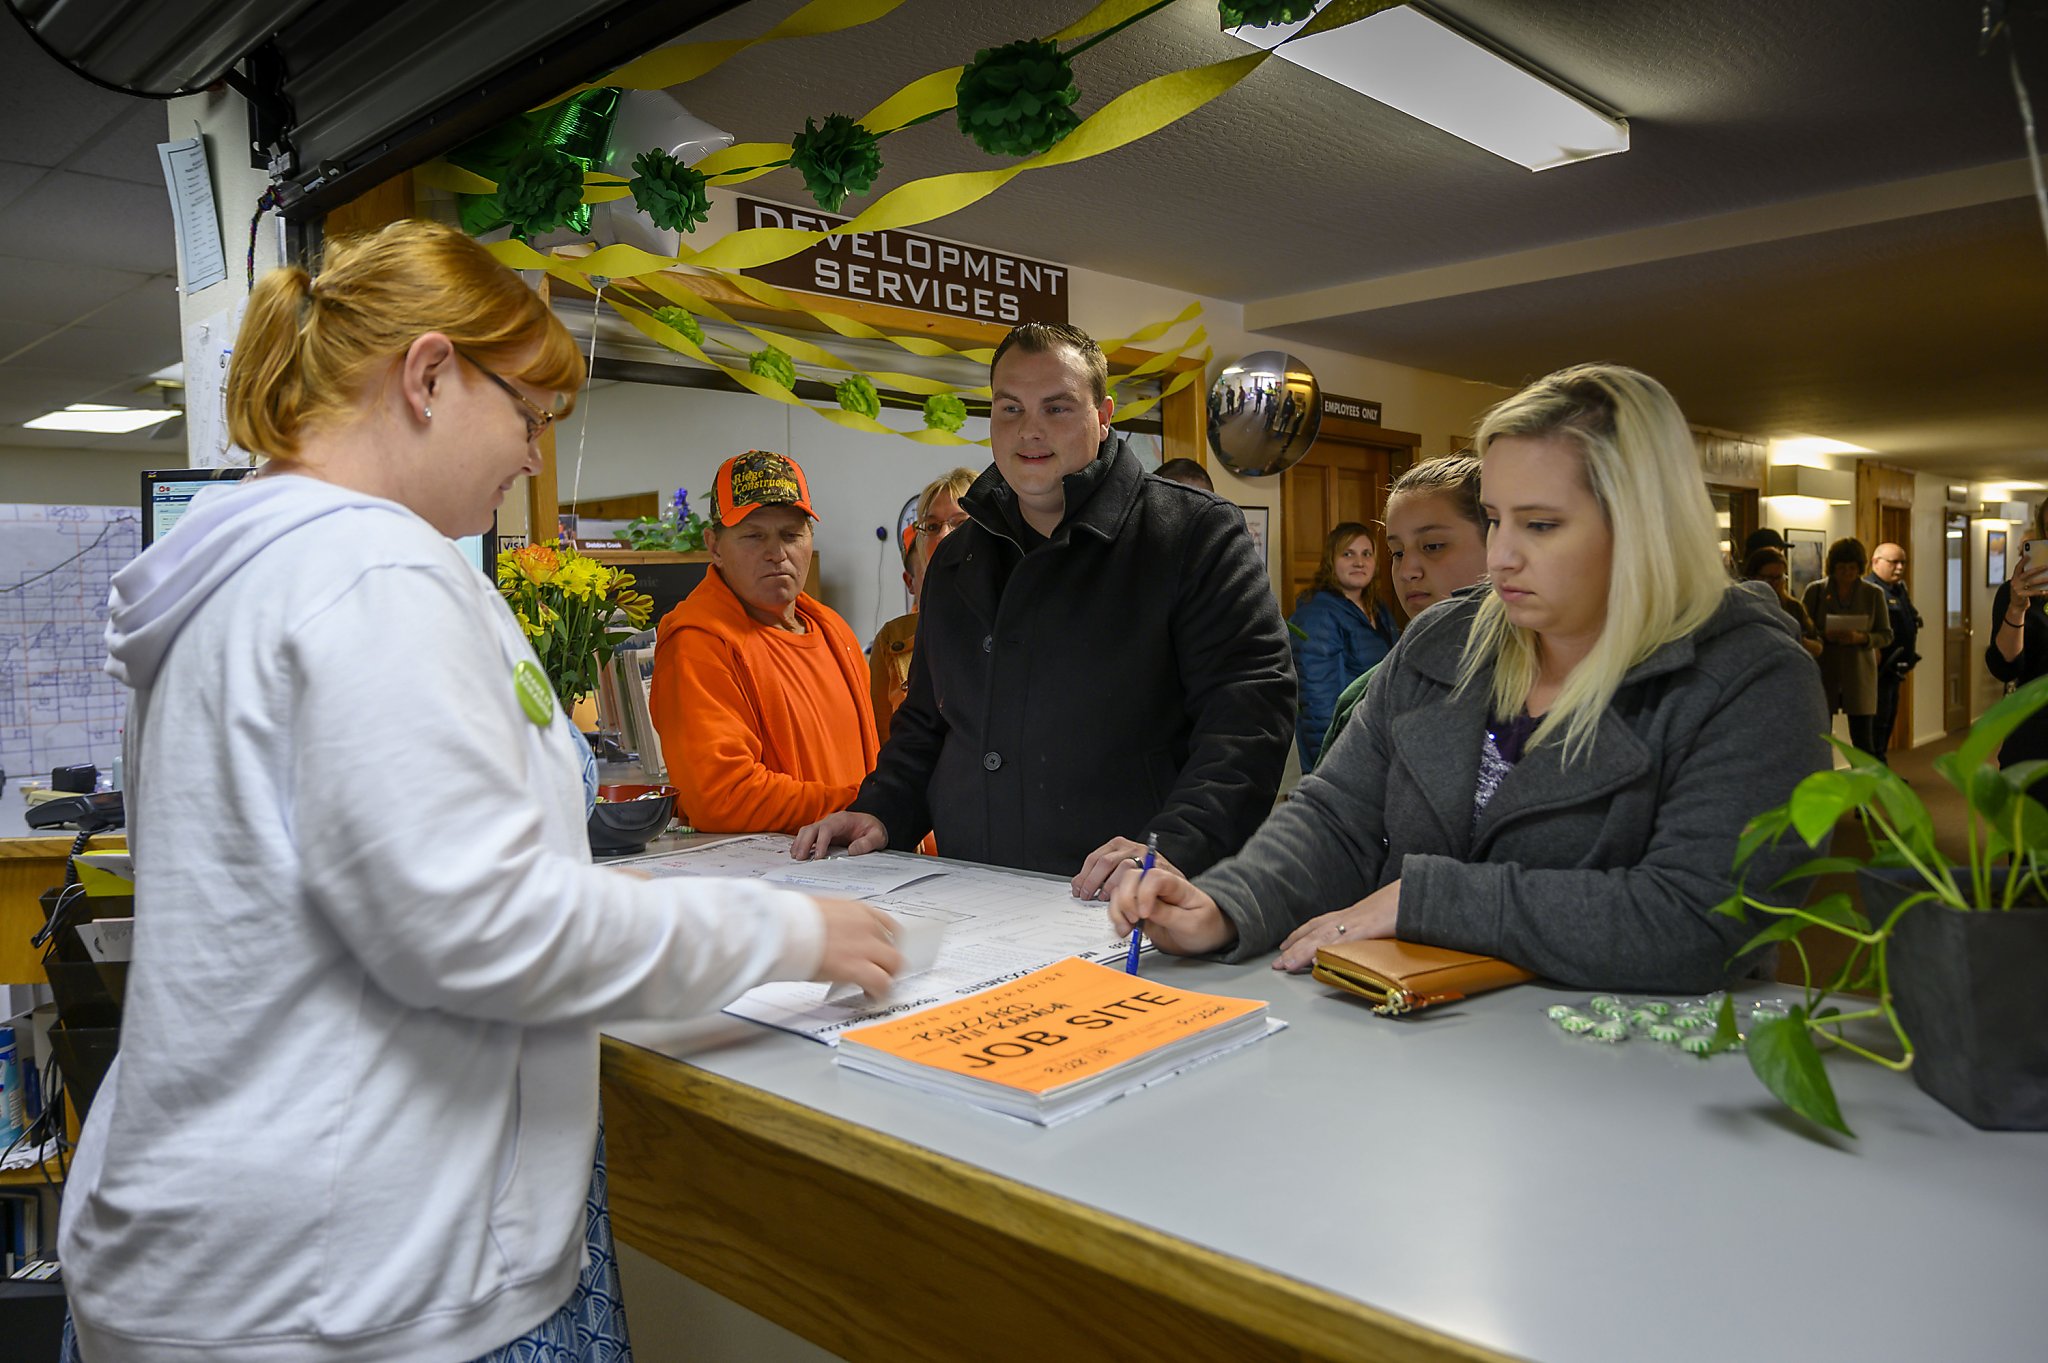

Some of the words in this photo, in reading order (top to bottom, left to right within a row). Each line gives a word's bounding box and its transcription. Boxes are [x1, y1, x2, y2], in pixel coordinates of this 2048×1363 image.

[754, 205, 1064, 296] DEVELOPMENT
[815, 257, 1019, 322] SERVICES
[1324, 400, 1360, 418] EMPLOYEES
[1362, 407, 1378, 421] ONLY
[733, 469, 764, 485] Ridge
[735, 478, 798, 495] Construction
[503, 541, 525, 550] VISA
[606, 541, 622, 549] Cook
[884, 1016, 940, 1034] TOWN
[950, 1006, 970, 1015] OF
[981, 972, 1065, 1005] PARADISE
[961, 1030, 1068, 1068] JOB
[1066, 991, 1180, 1029] SITE
